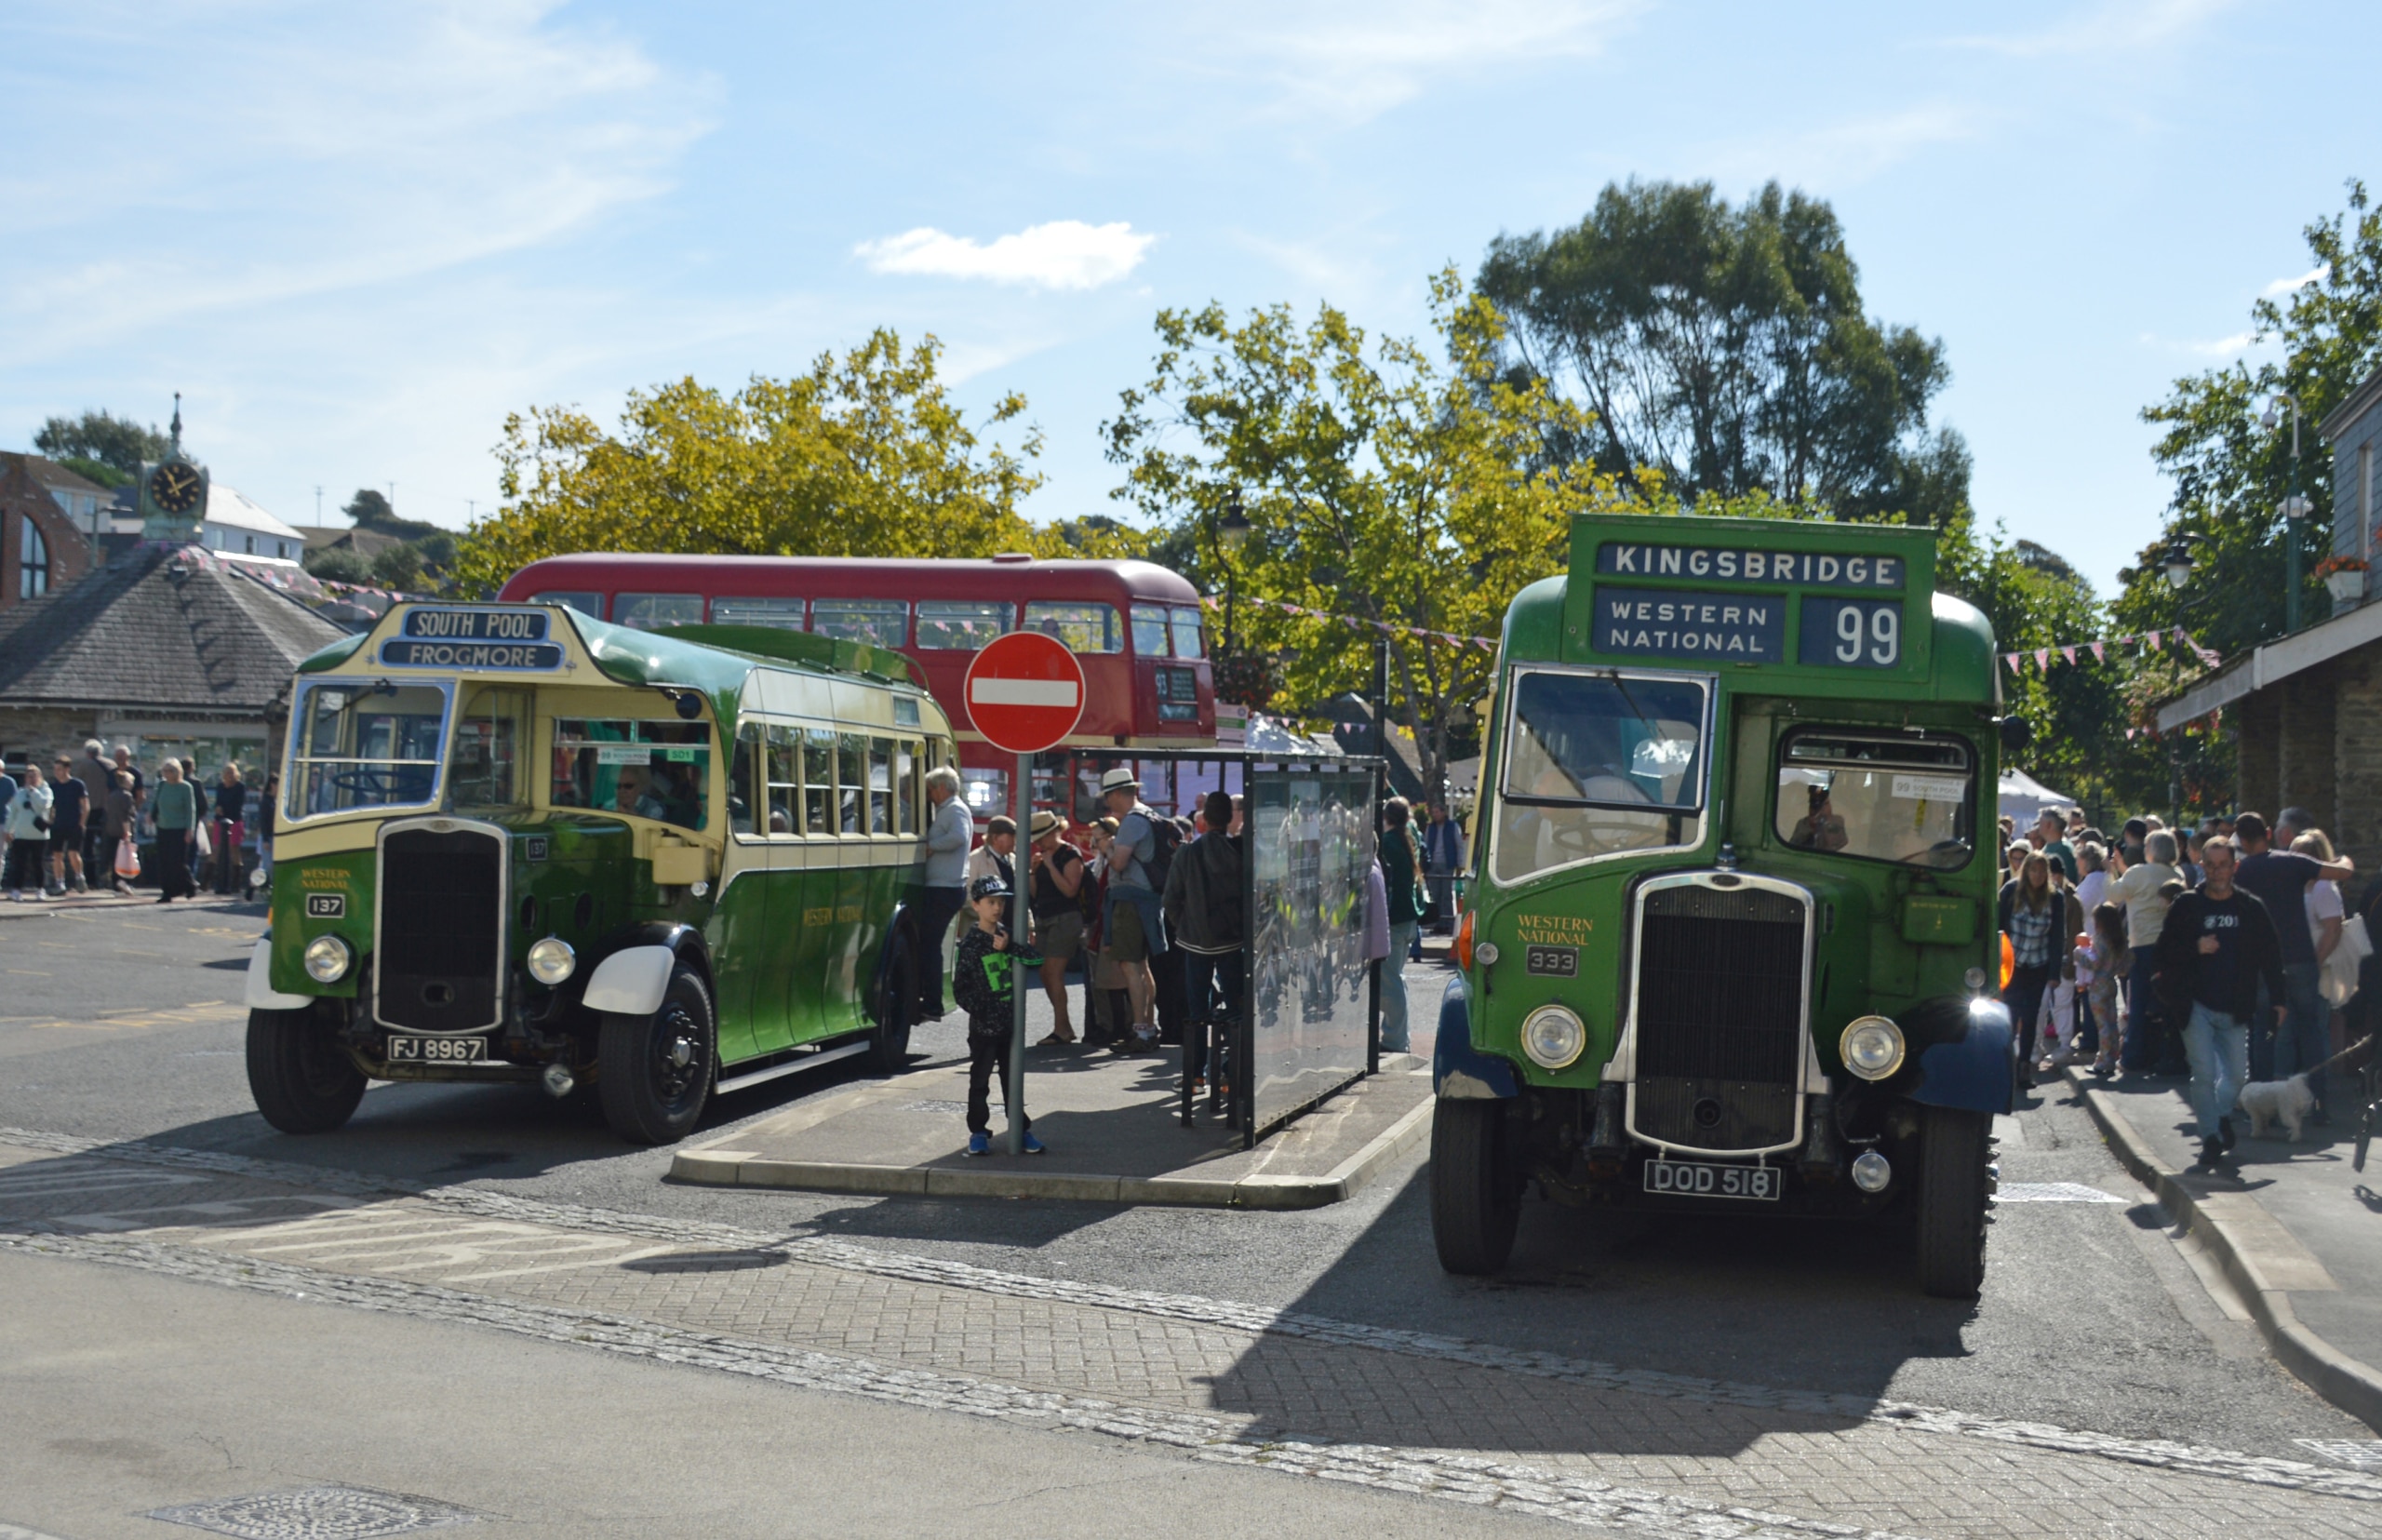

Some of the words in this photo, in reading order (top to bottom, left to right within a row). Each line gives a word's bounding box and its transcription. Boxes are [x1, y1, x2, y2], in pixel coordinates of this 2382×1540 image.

[1615, 545, 1896, 585] KINGSBRIDGE
[416, 612, 475, 637] SOUTH
[486, 613, 534, 638] POOL
[1611, 601, 1767, 626] WESTERN
[1611, 629, 1764, 653] NATIONAL
[1836, 606, 1898, 665] 99
[409, 644, 536, 667] FROGMORE
[672, 749, 690, 759] SD1
[313, 898, 341, 913] 137
[1518, 914, 1593, 931] WESTERN
[1518, 928, 1589, 946] NATIONAL
[1531, 952, 1574, 970] 333
[394, 1038, 419, 1058] FJ
[424, 1039, 482, 1060] 8967
[1654, 1164, 1714, 1192] DOD
[1722, 1169, 1770, 1197] 518
